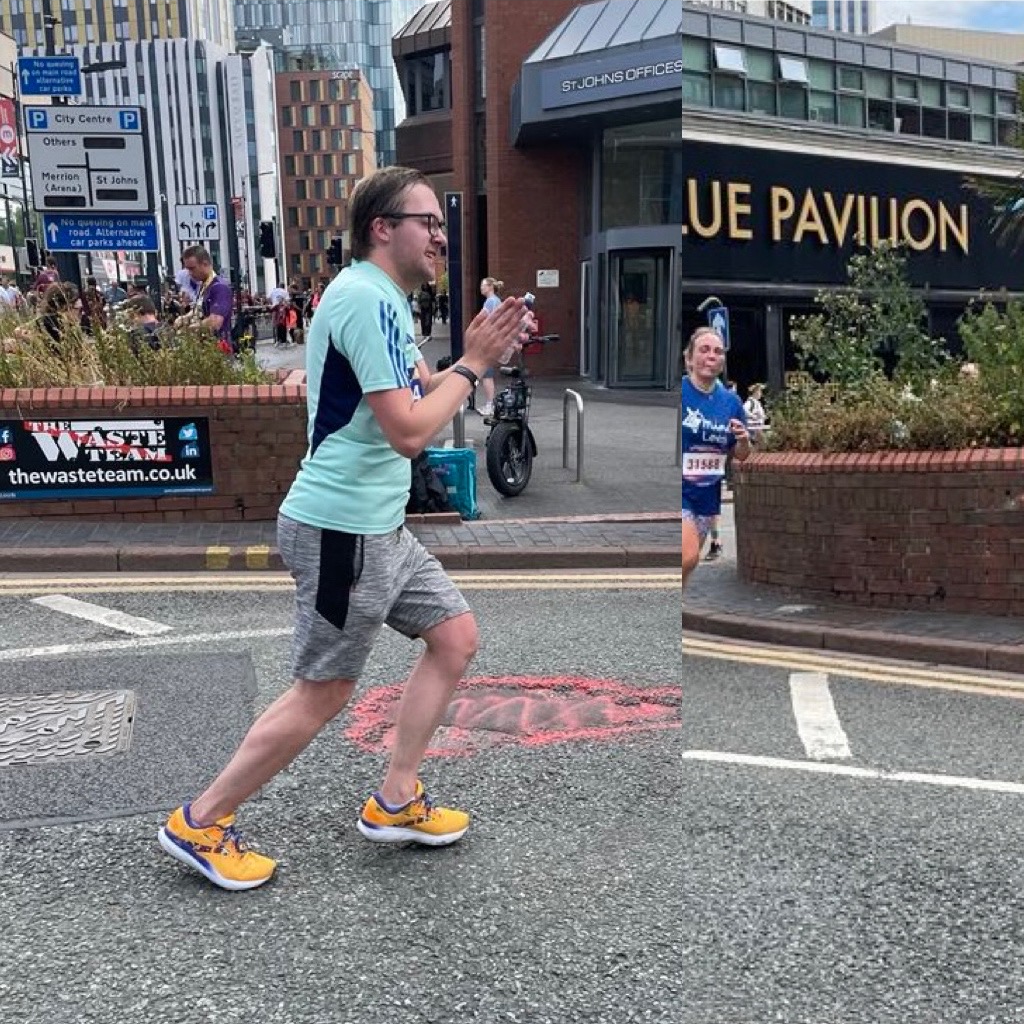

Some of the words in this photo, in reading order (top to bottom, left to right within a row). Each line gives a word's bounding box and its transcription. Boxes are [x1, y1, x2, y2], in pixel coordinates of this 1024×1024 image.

[42, 68, 59, 76] main
[60, 68, 77, 76] road
[577, 71, 624, 89] JOHNS
[625, 59, 682, 81] OFFICES
[36, 76, 75, 84] alternative
[52, 85, 73, 93] parks
[32, 112, 45, 127] P
[54, 114, 75, 124] City
[78, 115, 113, 124] Centre
[123, 113, 135, 128] P
[43, 137, 77, 147] Others
[41, 172, 80, 182] Merrion
[96, 176, 109, 185] St
[111, 175, 139, 185] Johns
[44, 183, 83, 193] (Arena)
[682, 179, 753, 240] UE
[770, 186, 969, 256] PAVILION
[60, 218, 74, 226] No
[77, 218, 114, 229] queuing
[130, 218, 153, 227] main
[69, 228, 92, 237] road.
[95, 227, 146, 237] Alternative
[70, 239, 85, 247] car
[88, 238, 114, 249] parks
[116, 237, 146, 248] ahead.
[29, 420, 71, 431] THE
[31, 430, 167, 462] WASTE
[85, 448, 168, 462] TEAM
[8, 464, 197, 485] thewasteteam.co.uk
